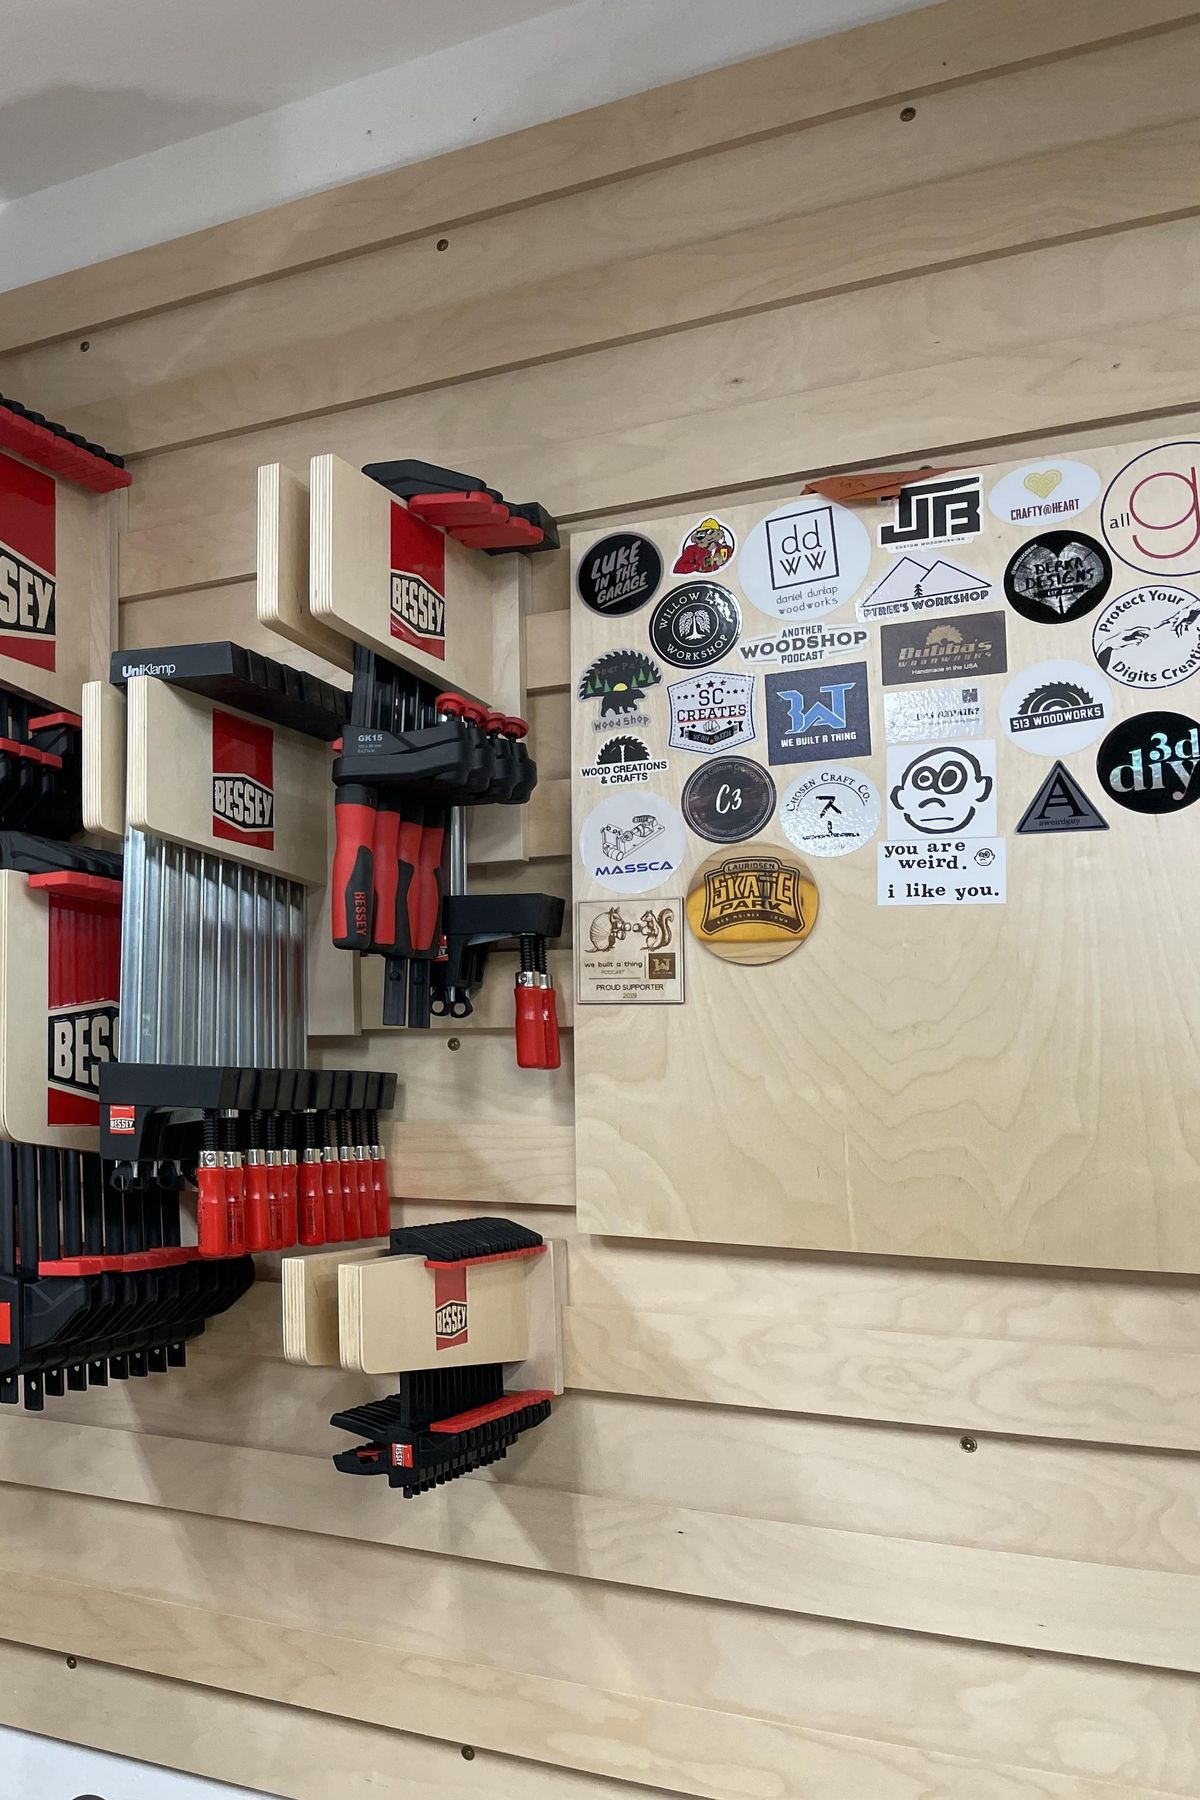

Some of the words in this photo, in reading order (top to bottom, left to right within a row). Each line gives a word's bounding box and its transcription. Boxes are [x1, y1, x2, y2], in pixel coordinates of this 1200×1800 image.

[1010, 498, 1080, 521] CRAFTY@HEART
[1109, 512, 1131, 529] all
[591, 540, 641, 580] LUKE
[594, 574, 610, 593] IN
[615, 561, 639, 583] THE
[1025, 568, 1095, 590] DESIGNS
[596, 571, 648, 604] GARAGE
[776, 590, 803, 605] daniel
[807, 585, 839, 599] dunlap
[392, 577, 445, 634] BESSEY
[778, 597, 839, 615] woodworks
[912, 590, 989, 611] WORKSHOP
[659, 591, 701, 630] WILLOW
[1098, 593, 1146, 632] Protect
[1148, 590, 1185, 605] Your
[781, 624, 823, 638] ANOTHER
[666, 634, 728, 661] WORKSHOP
[740, 631, 867, 659] WOODSHOP
[781, 650, 825, 664] PODCAST
[122, 662, 176, 678] UniKlamp
[911, 666, 945, 676] Handmade
[1112, 661, 1158, 683] Digits
[698, 688, 724, 706] SC
[677, 704, 747, 722] CREATES
[1012, 718, 1030, 730] 513
[1033, 706, 1101, 727] WOODWORKS
[593, 720, 621, 731] Wood
[624, 715, 650, 726] Shop
[358, 733, 383, 742] GK15
[781, 738, 794, 748] WE
[796, 735, 820, 746] BUILT
[831, 731, 857, 742] THING
[581, 766, 611, 777] WOOD
[613, 760, 667, 774] CREATIONS
[600, 776, 608, 784] &
[610, 772, 648, 784] CRAFTS
[1109, 749, 1200, 801] diy
[214, 780, 273, 826] BESSEY
[715, 783, 742, 814] C3
[1033, 772, 1090, 820] A
[1039, 818, 1081, 828] aweirdguy
[884, 845, 919, 858] you
[926, 841, 966, 853] are
[595, 860, 674, 877] MASSCA
[727, 861, 775, 872] LAURIDSEN
[711, 871, 793, 908] SKATE
[887, 884, 895, 898] i
[905, 882, 946, 898] like
[955, 885, 1000, 901] you.
[353, 891, 367, 936] BESSEY
[719, 899, 785, 915] PARK
[624, 961, 643, 969] thing
[595, 983, 621, 991] PROUD
[622, 983, 664, 991] SUPPORTER
[54, 1014, 120, 1087] BES
[110, 1119, 134, 1129] BESSEY
[436, 1305, 467, 1334] BESSEY
